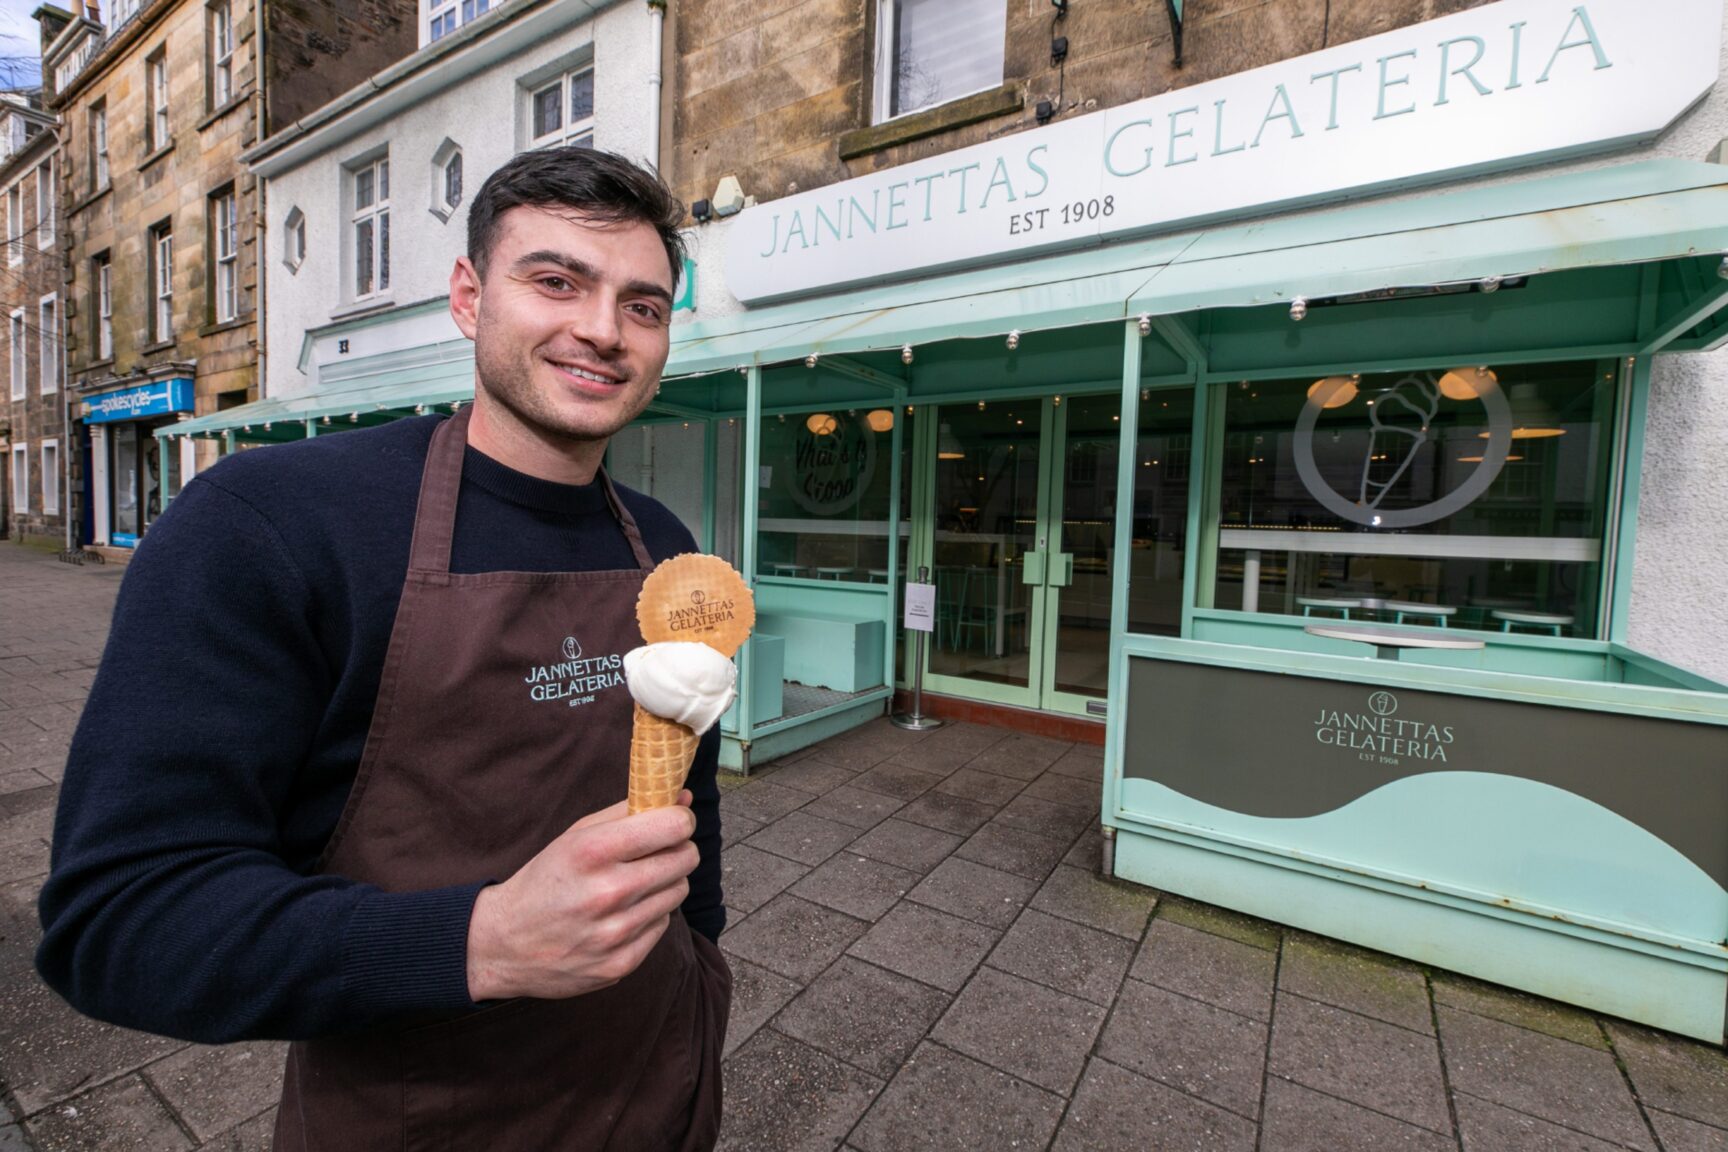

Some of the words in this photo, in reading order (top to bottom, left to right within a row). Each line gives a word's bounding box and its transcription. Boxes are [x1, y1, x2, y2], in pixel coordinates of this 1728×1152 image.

[760, 144, 1050, 258] JANNETTAS
[1103, 4, 1613, 178] GELATERIA
[1009, 207, 1050, 235] EST
[1060, 195, 1115, 225] 1908
[667, 599, 735, 622] JANNETTAS
[670, 610, 735, 632] GELATERIA
[525, 654, 622, 684] JANNETTAS
[530, 671, 626, 701] GELATERIA
[1314, 709, 1455, 744] JANNETTAS
[1316, 727, 1448, 762] GELATERIA
[1359, 752, 1375, 762] EST
